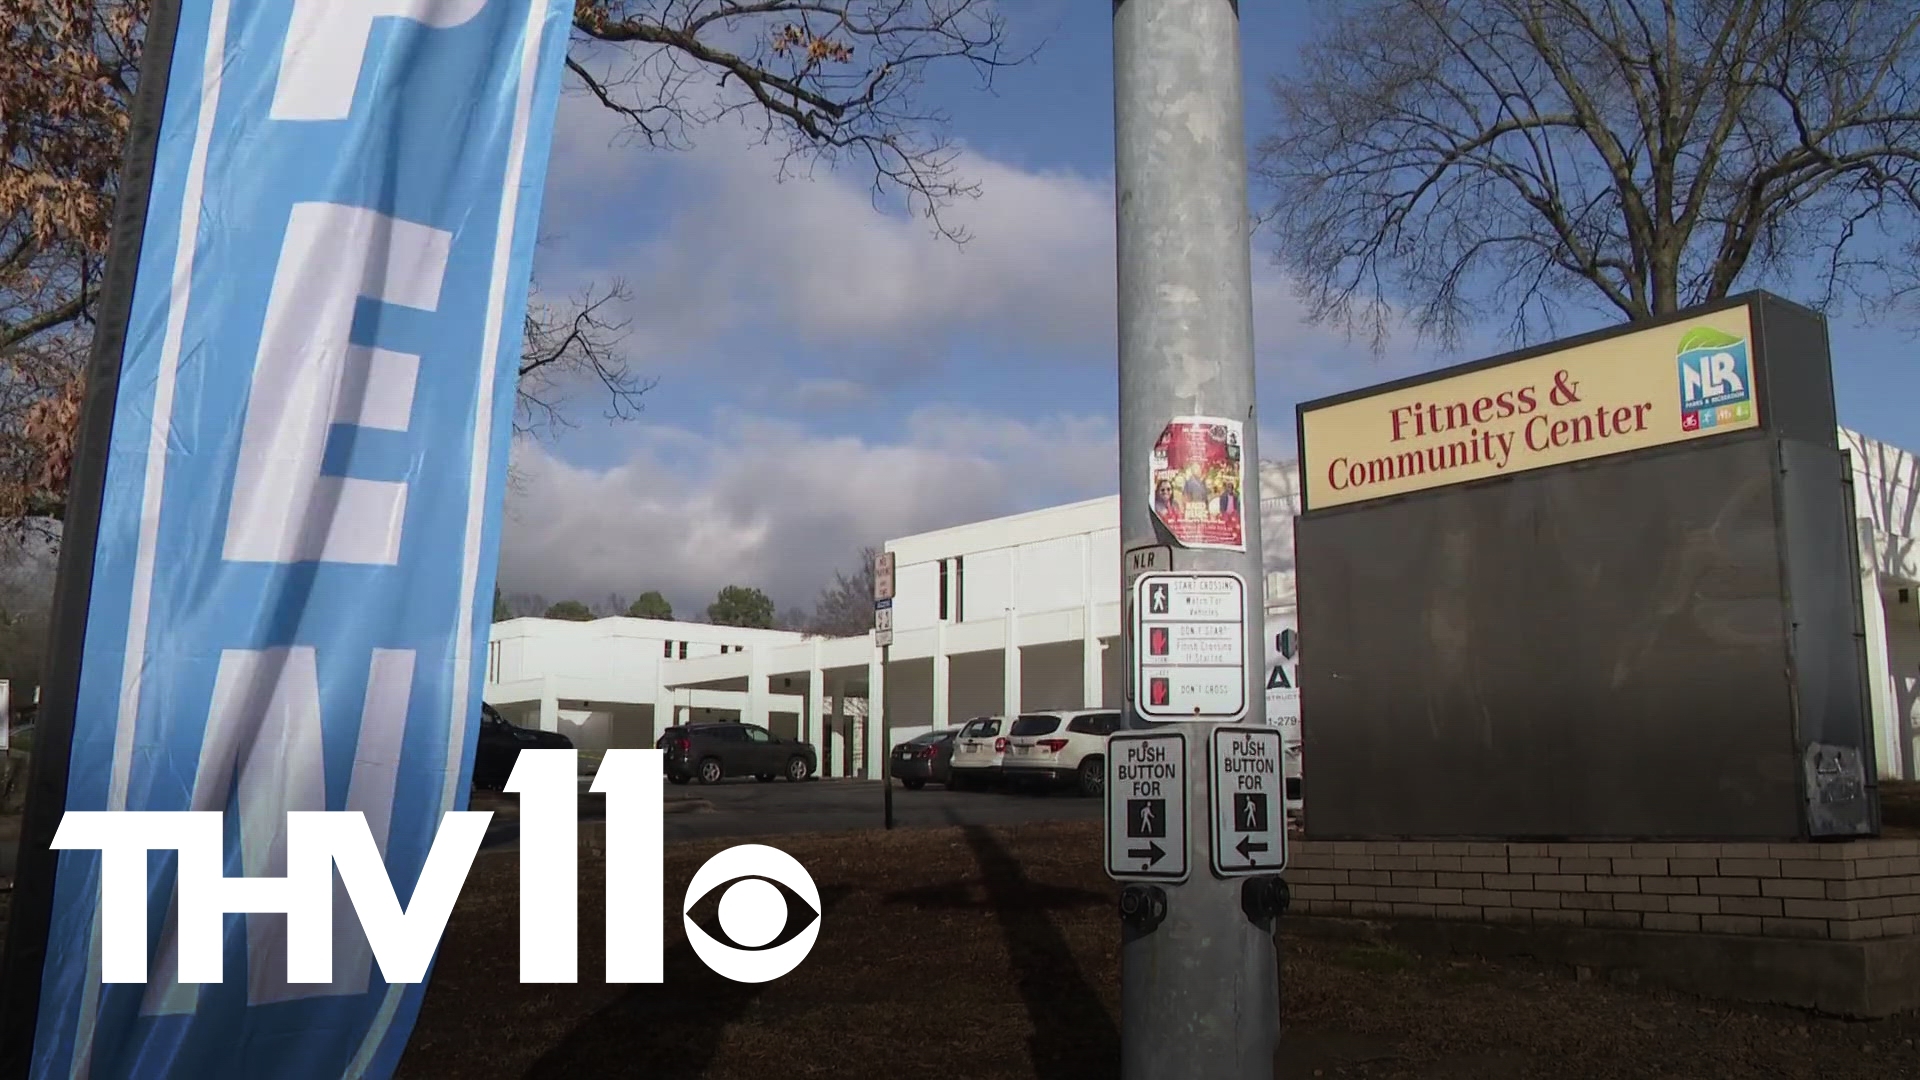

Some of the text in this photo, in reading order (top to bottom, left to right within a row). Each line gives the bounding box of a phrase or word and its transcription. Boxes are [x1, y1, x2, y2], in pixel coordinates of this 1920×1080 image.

[1682, 352, 1745, 402] NLR
[1389, 369, 1582, 443] Fitness &
[1328, 401, 1653, 492] Community Center
[1133, 551, 1155, 570] NLR
[1174, 580, 1234, 591] START CROSSING
[1127, 746, 1166, 763] PUSH
[1232, 740, 1266, 756] PUSH
[1118, 764, 1176, 780] BUTTON
[1224, 758, 1274, 774] BUTTON
[1132, 781, 1161, 796] FOR
[1238, 775, 1263, 790] FOR
